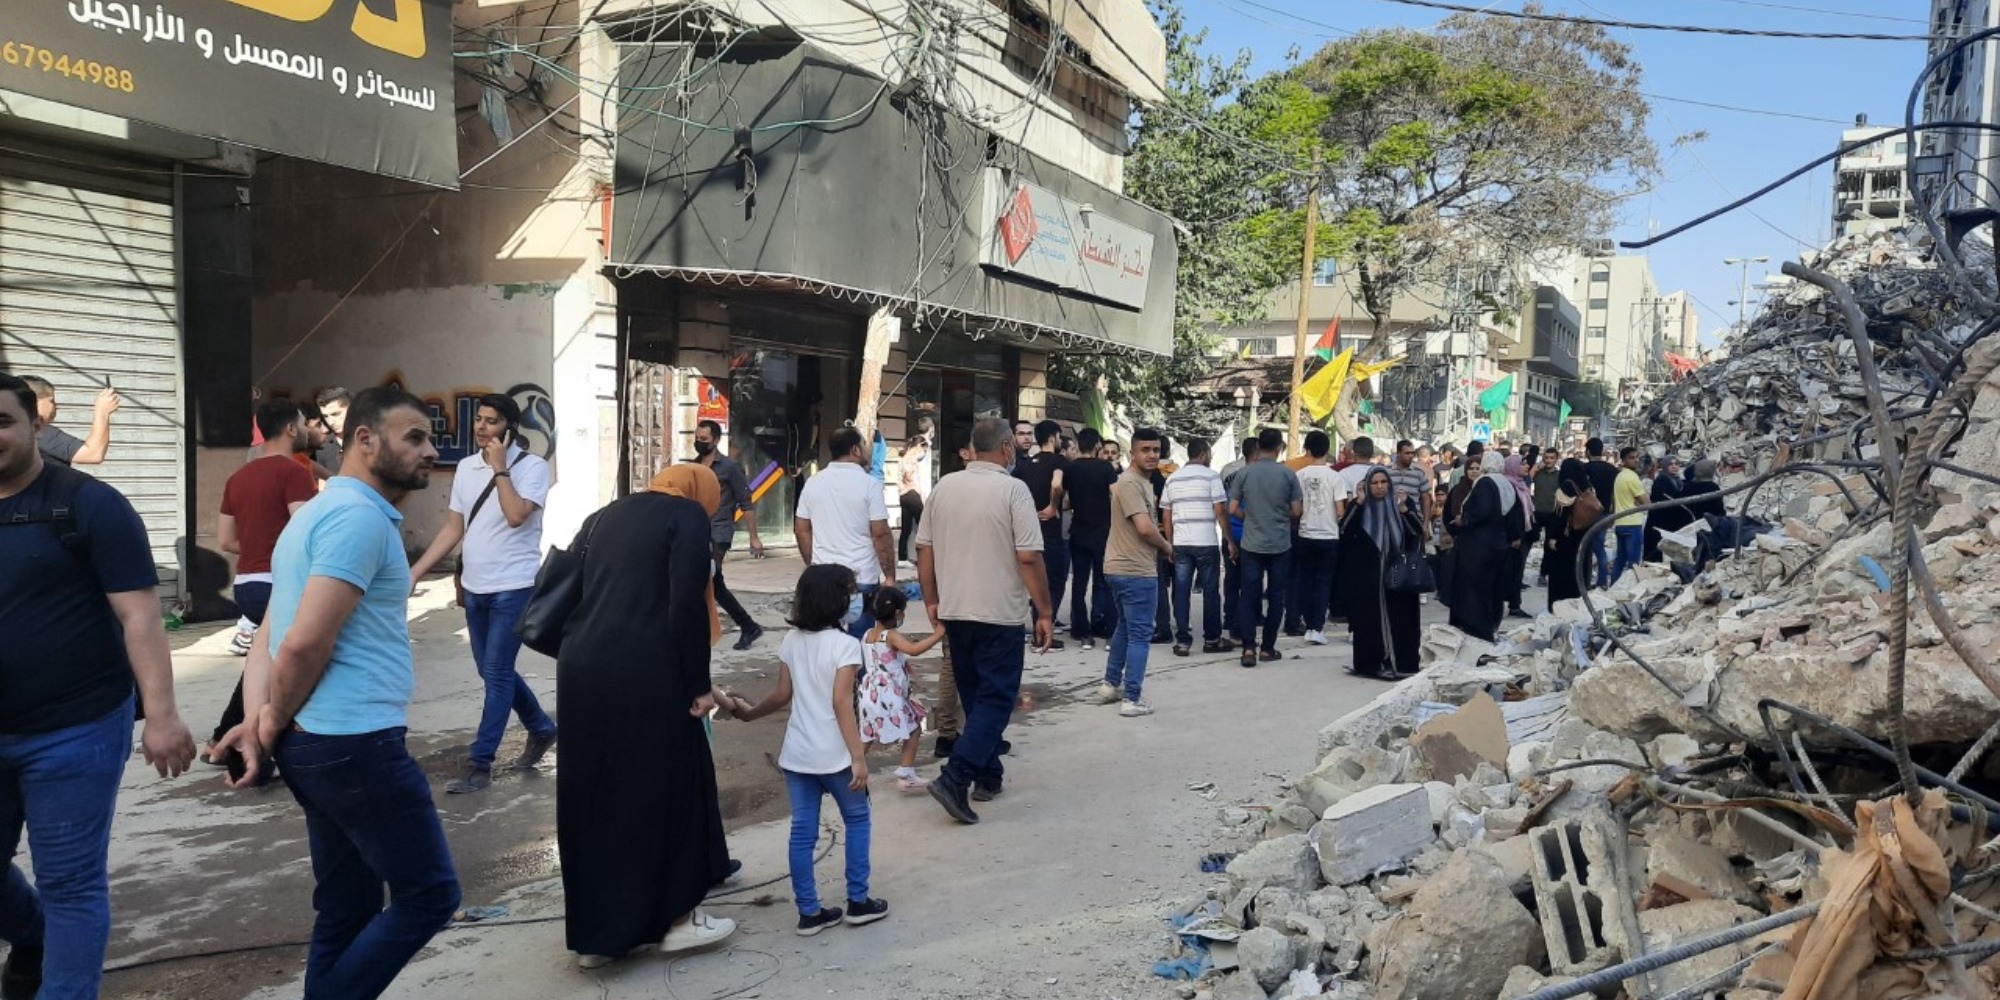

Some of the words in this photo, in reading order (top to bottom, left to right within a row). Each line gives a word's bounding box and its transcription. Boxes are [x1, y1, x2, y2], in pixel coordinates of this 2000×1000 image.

[68, 0, 186, 43] الأراجيل
[194, 27, 214, 59] و
[2, 40, 135, 93] 67944988
[223, 33, 325, 81] المعسل
[332, 66, 348, 94] و
[354, 69, 436, 112] للسجائر
